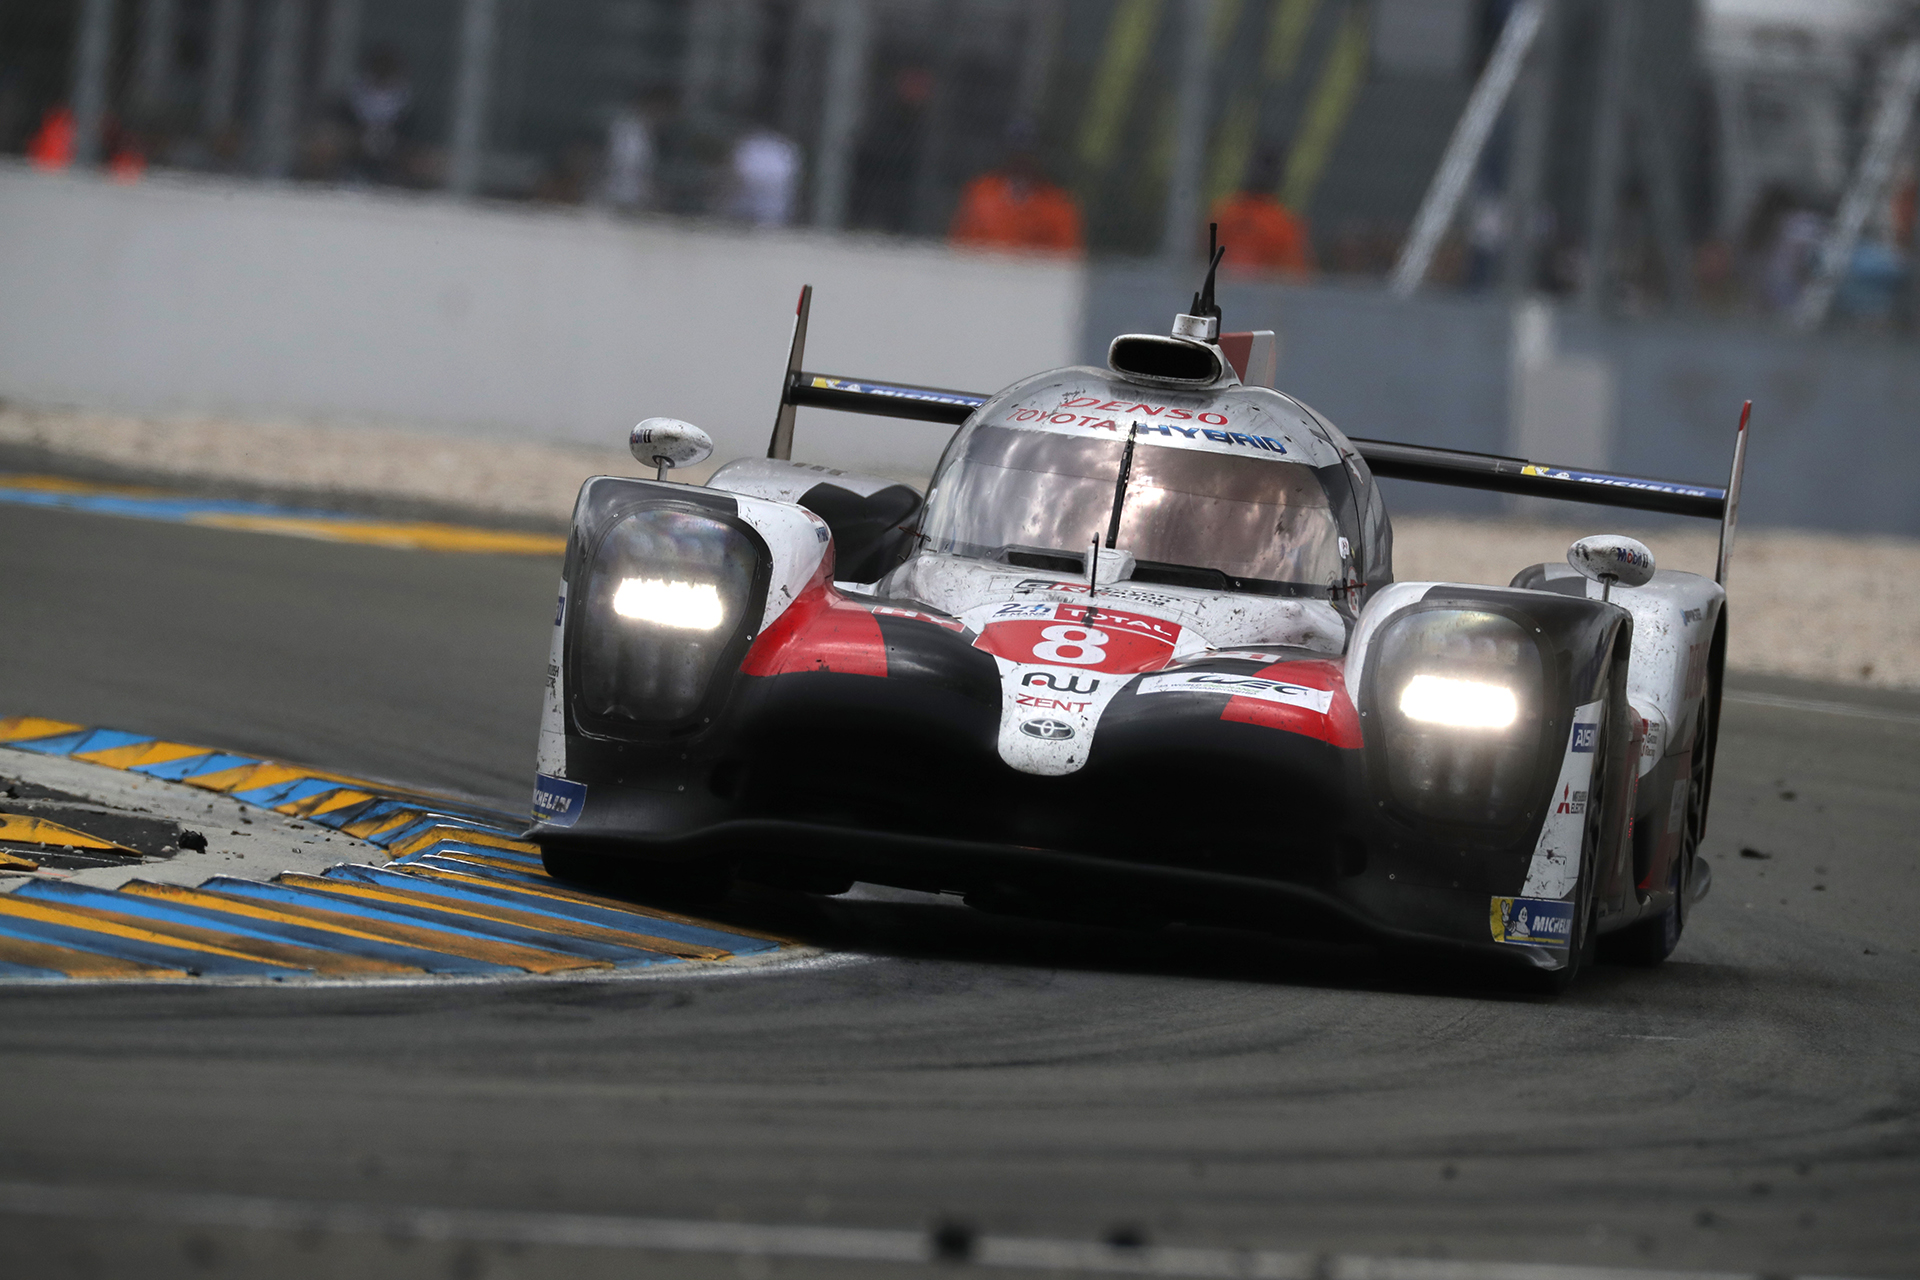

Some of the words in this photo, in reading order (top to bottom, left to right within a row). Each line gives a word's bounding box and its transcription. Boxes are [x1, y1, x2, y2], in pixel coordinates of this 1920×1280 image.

[870, 388, 983, 407] MICHELI
[1060, 397, 1229, 426] DENSO
[1006, 408, 1117, 432] TOYOTA
[1137, 423, 1288, 455] HYBRID
[1578, 476, 1706, 497] MICHELIN
[1063, 608, 1173, 637] TOTAL
[1032, 625, 1110, 665] 8
[1015, 692, 1093, 713] ZENT
